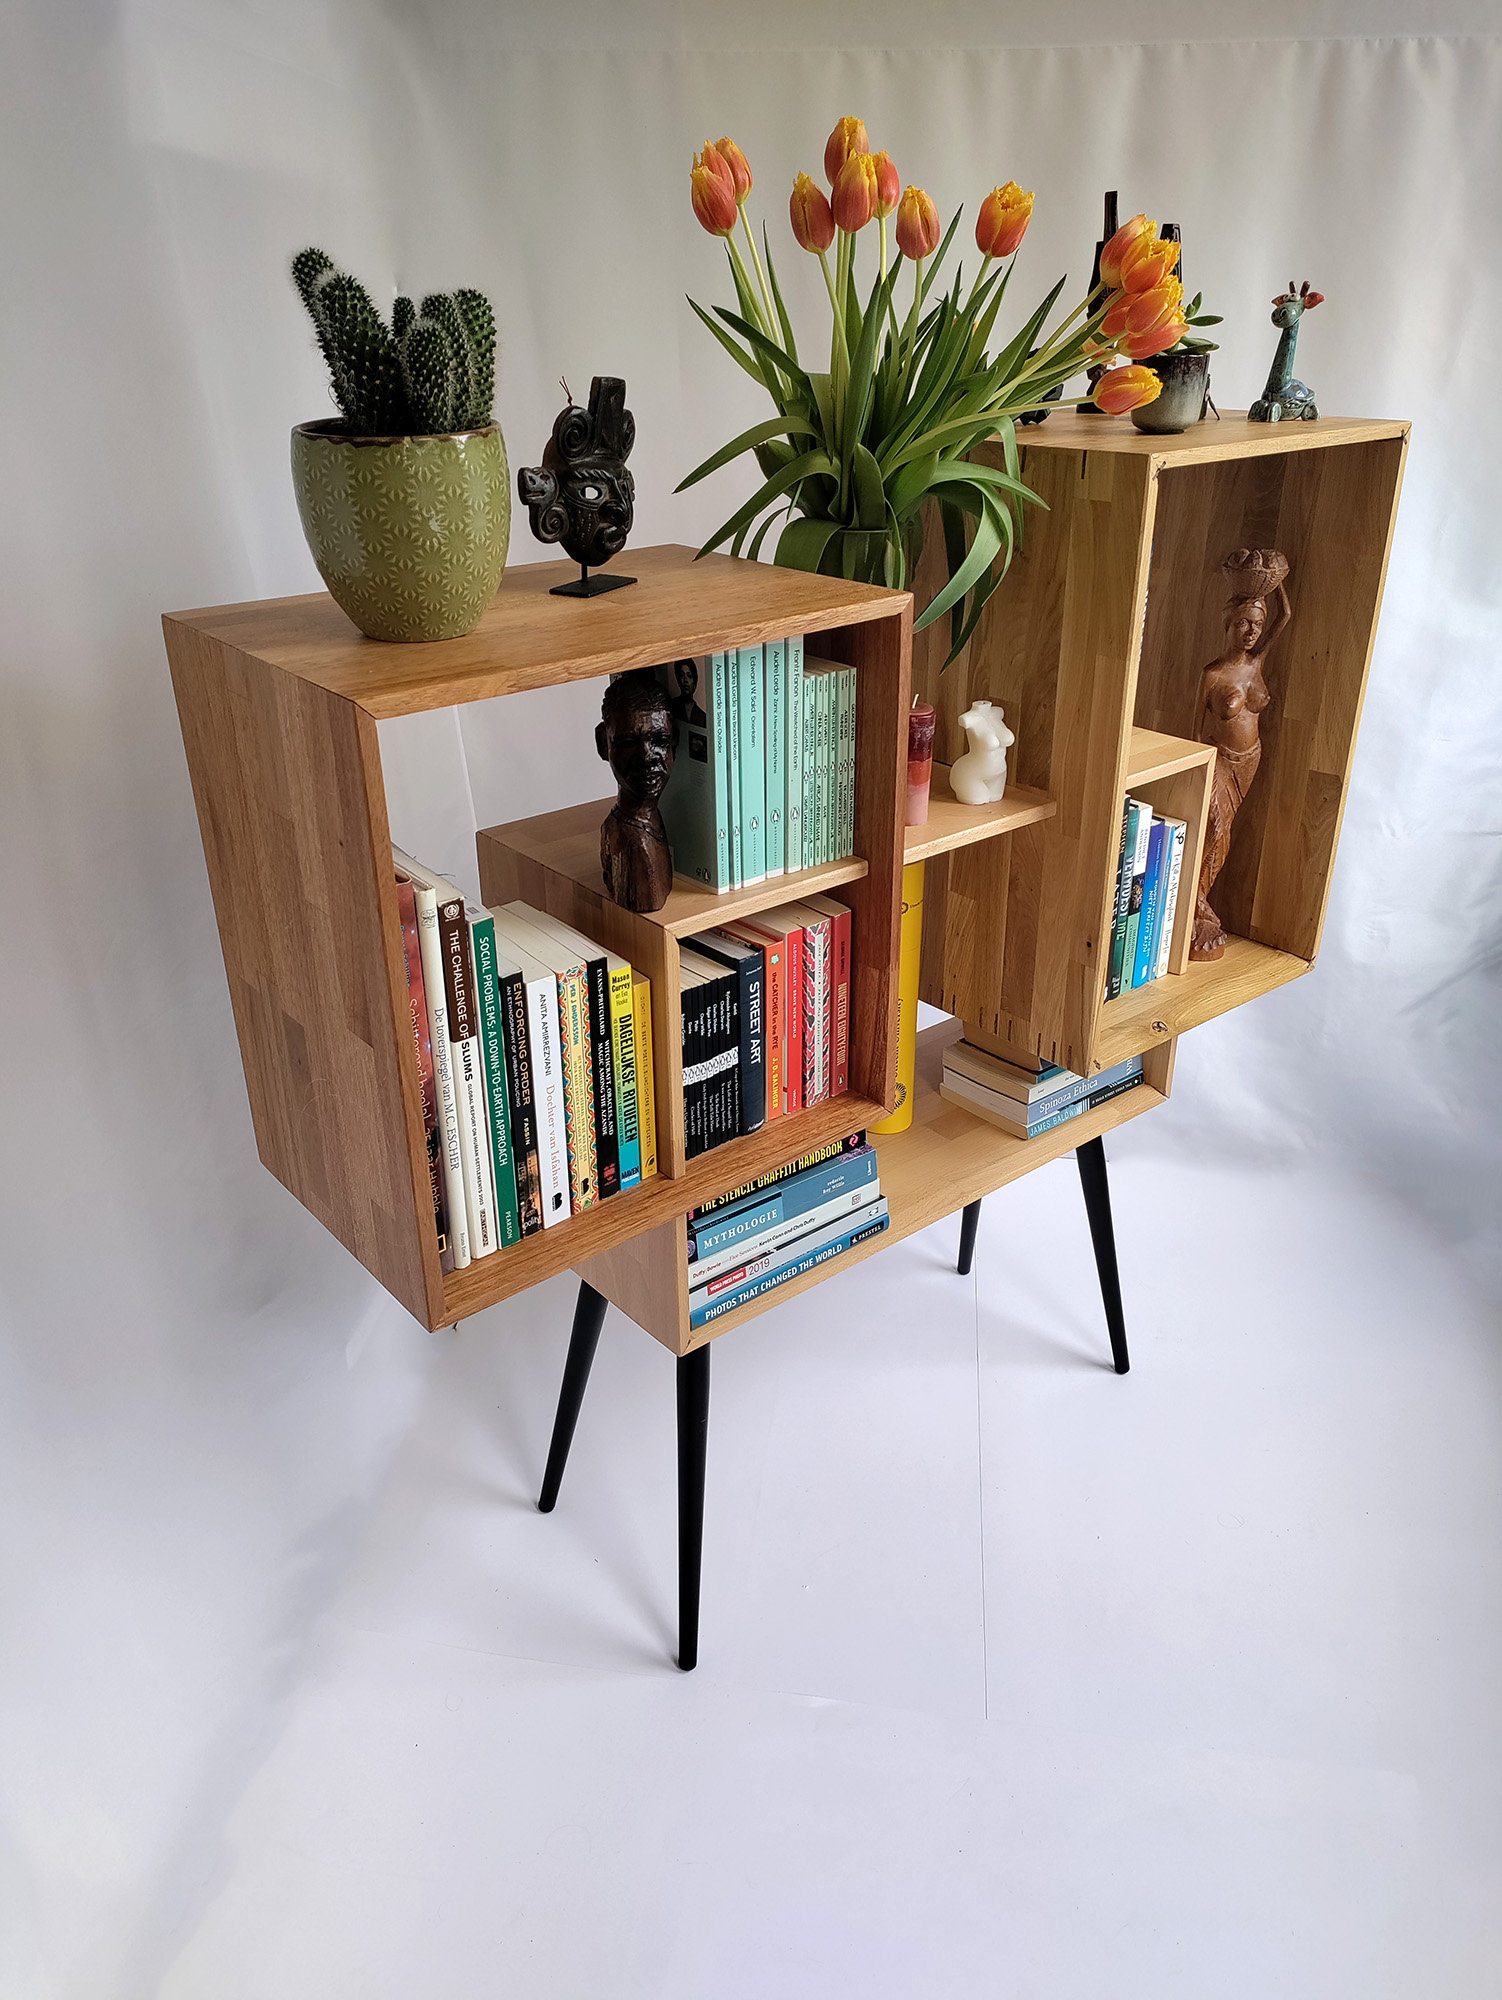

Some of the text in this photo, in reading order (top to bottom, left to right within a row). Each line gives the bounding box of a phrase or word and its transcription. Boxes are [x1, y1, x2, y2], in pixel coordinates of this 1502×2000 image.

[1117, 921, 1126, 941] ME
[478, 937, 491, 973] SOCIAL
[505, 986, 511, 995] AN
[612, 974, 629, 984] Mason
[612, 982, 630, 992] Currey
[837, 982, 846, 1019] NINETEEN
[448, 929, 472, 1081] THE CHALLENGE OF SLUMS
[482, 974, 496, 1029] PROBLEMS:
[506, 997, 515, 1044] ETHNOGRAPHY
[513, 982, 527, 1058] ENFORCING
[596, 968, 605, 1035] EVANS-PRITCHARD
[749, 982, 760, 1033] STREET
[539, 993, 551, 1076] ANITA AMIRREZVANI
[750, 1039, 760, 1065] ART
[836, 1020, 846, 1065] EIGHTY-FOUR
[487, 1039, 503, 1118] DOWN-TO-EARTH
[519, 1061, 530, 1106] ORDER
[603, 1039, 611, 1088] WITCHCRAFT,
[618, 1014, 638, 1143] DAGELIJKSE RITUELEN
[772, 1065, 777, 1073] D.
[433, 1008, 459, 1170] De toverspiegel van M.C. ESCHER
[513, 1078, 521, 1107] POLICING
[545, 1084, 557, 1127] Dochter
[1039, 1093, 1071, 1114] Spinoza
[1074, 1080, 1098, 1096] Ethica
[1030, 1106, 1082, 1136] JAMES BALDWIN
[471, 1127, 477, 1135] ON
[474, 1157, 482, 1193] SETTLEMENTS
[495, 1120, 508, 1167] APPROACH
[550, 1150, 561, 1188] Isfahan
[719, 1182, 756, 1203] STENCIL
[758, 1162, 797, 1187] GRAFFITI
[799, 1141, 842, 1169] HANDBOOK
[504, 1211, 513, 1239] PEARSON
[703, 1210, 778, 1249] MYTHOLOGIE
[759, 1237, 772, 1246] Kevin
[803, 1217, 816, 1226] Duffy
[859, 1225, 881, 1240] PRESTEL
[705, 1244, 842, 1319] PHOTOS THAT CHANGED THE WORLD
[749, 1258, 770, 1275] 2019
